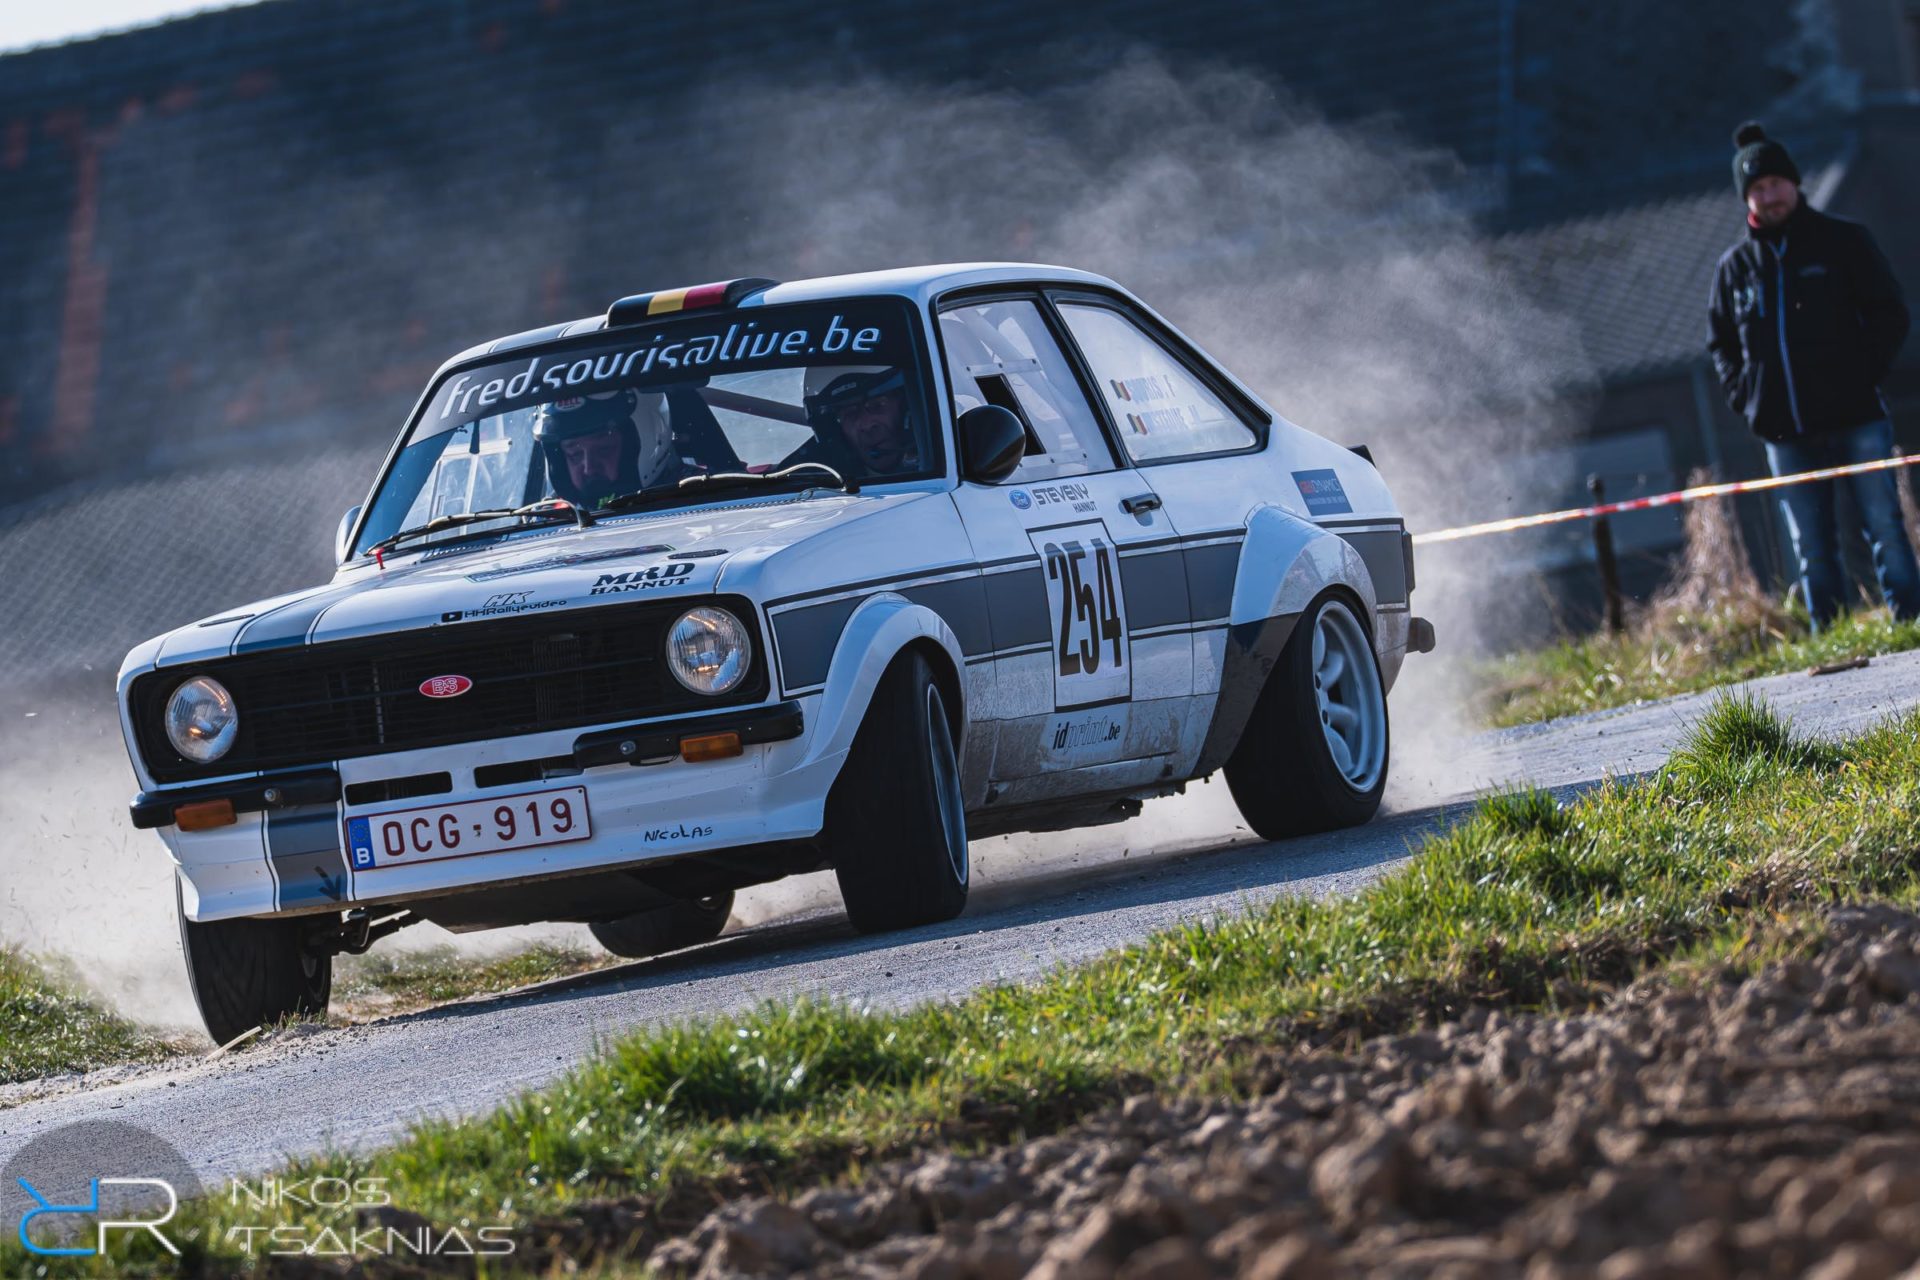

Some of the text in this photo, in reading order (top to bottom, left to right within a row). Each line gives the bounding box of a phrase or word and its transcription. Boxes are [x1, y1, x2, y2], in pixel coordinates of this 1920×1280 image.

[1032, 483, 1089, 505] STEVENY
[592, 562, 696, 587] MRD
[589, 577, 690, 596] HANNUT
[1044, 538, 1122, 676] 254
[356, 847, 371, 865] B
